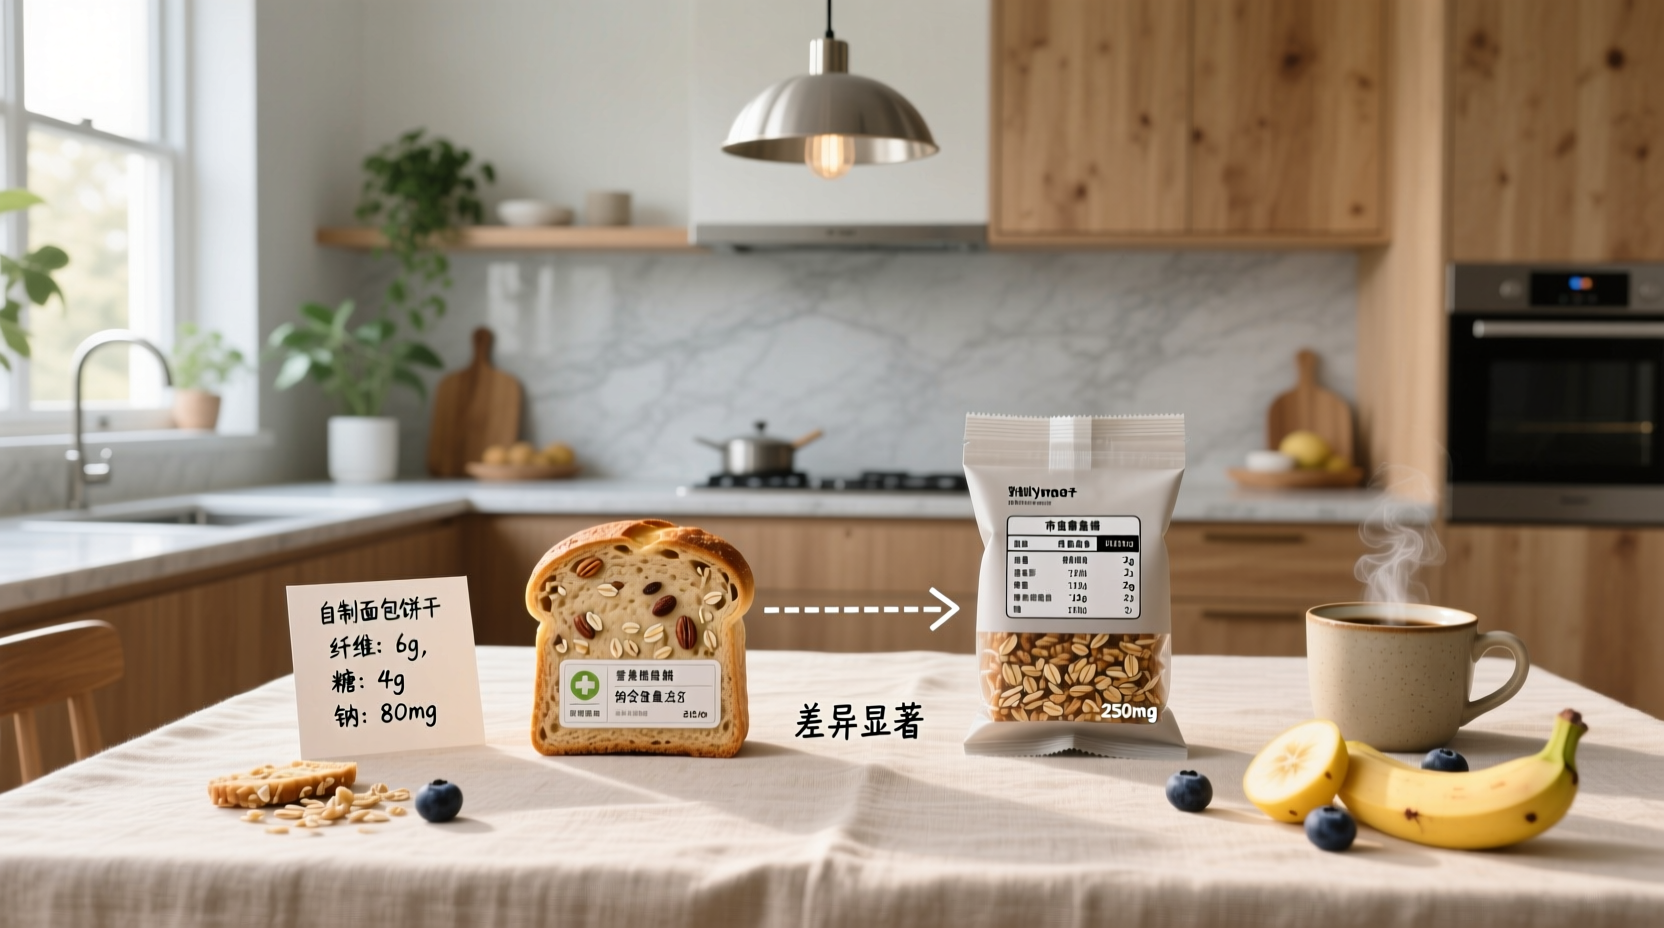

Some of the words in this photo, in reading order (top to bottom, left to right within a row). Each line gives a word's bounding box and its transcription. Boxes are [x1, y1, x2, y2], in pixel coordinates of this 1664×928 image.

[320, 596, 441, 626] 自制面包饼干
[1101, 702, 1158, 723] 250mg
